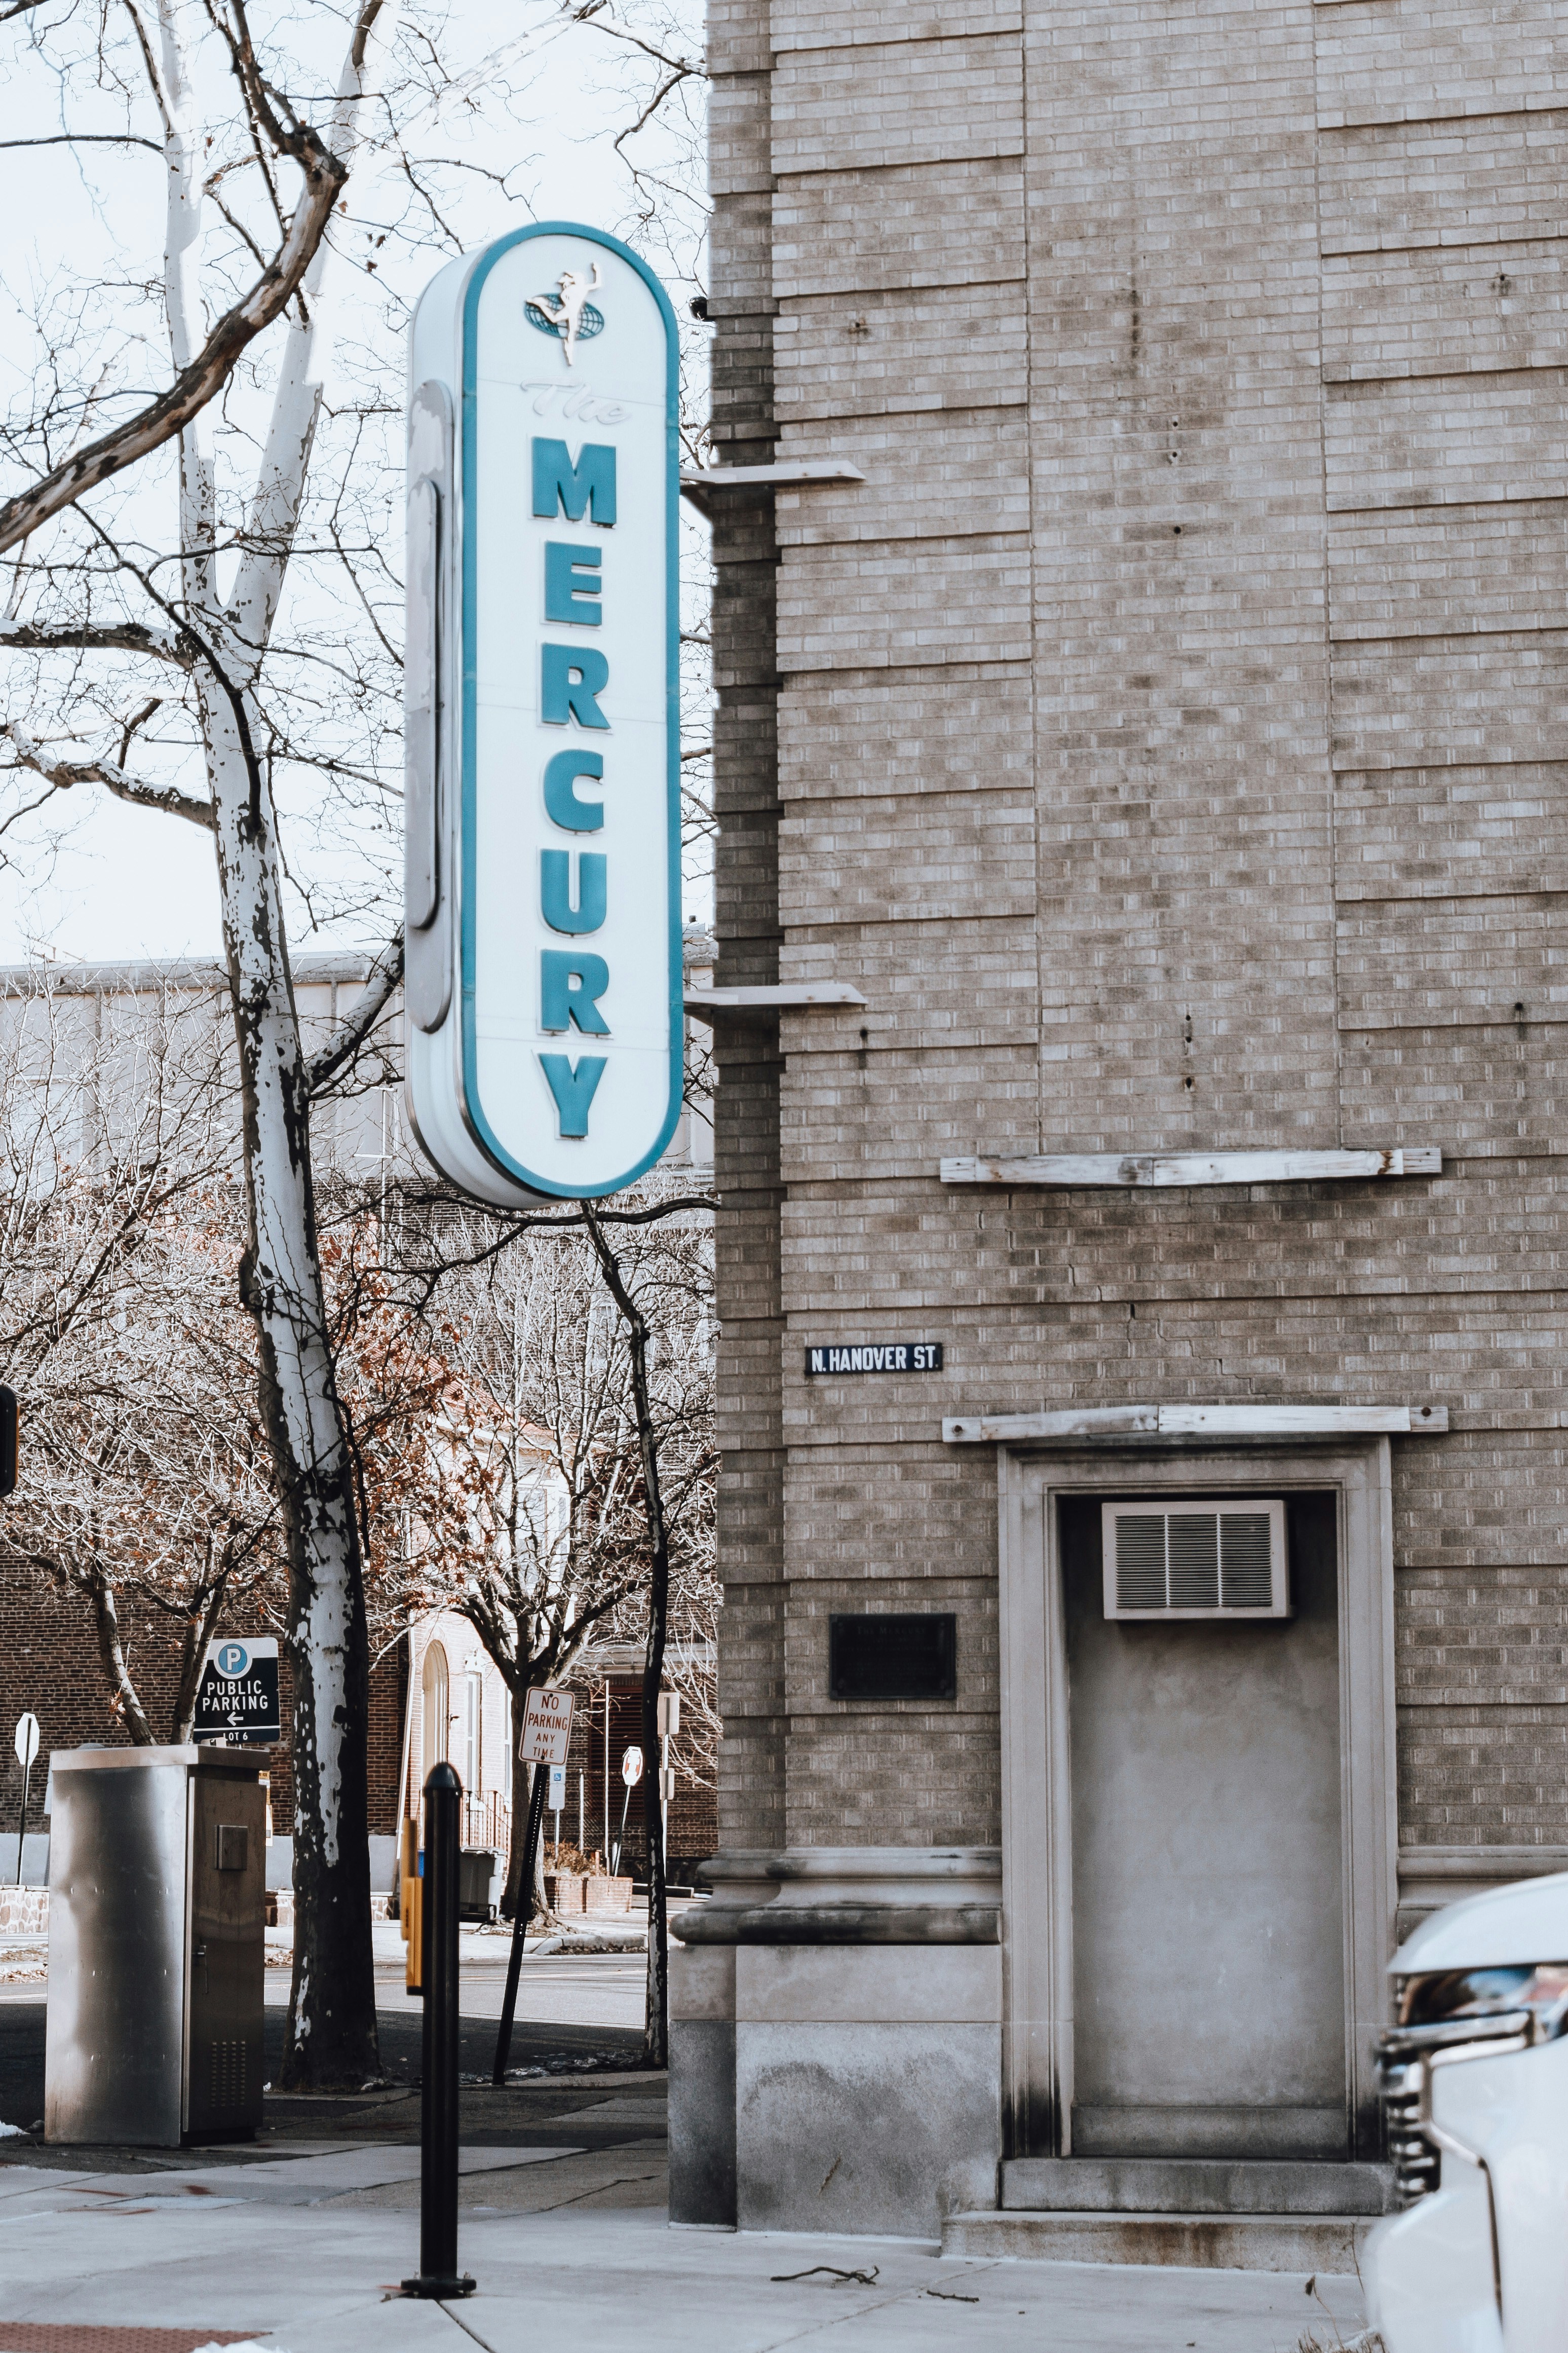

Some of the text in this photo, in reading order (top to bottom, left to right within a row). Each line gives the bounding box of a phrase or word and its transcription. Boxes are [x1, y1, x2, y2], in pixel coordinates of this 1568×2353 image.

[520, 375, 632, 425] The
[530, 435, 617, 1139] MERCURY
[812, 1349, 826, 1372] N.
[829, 1346, 906, 1371] HANOVER
[207, 1680, 262, 1696] PUBLIC
[203, 1695, 268, 1711] PARKING
[541, 1695, 559, 1710] NO
[528, 1712, 568, 1730] PARKING
[223, 1732, 248, 1741] LOT 6
[536, 1733, 555, 1743] ANY
[533, 1747, 555, 1759] TIME
